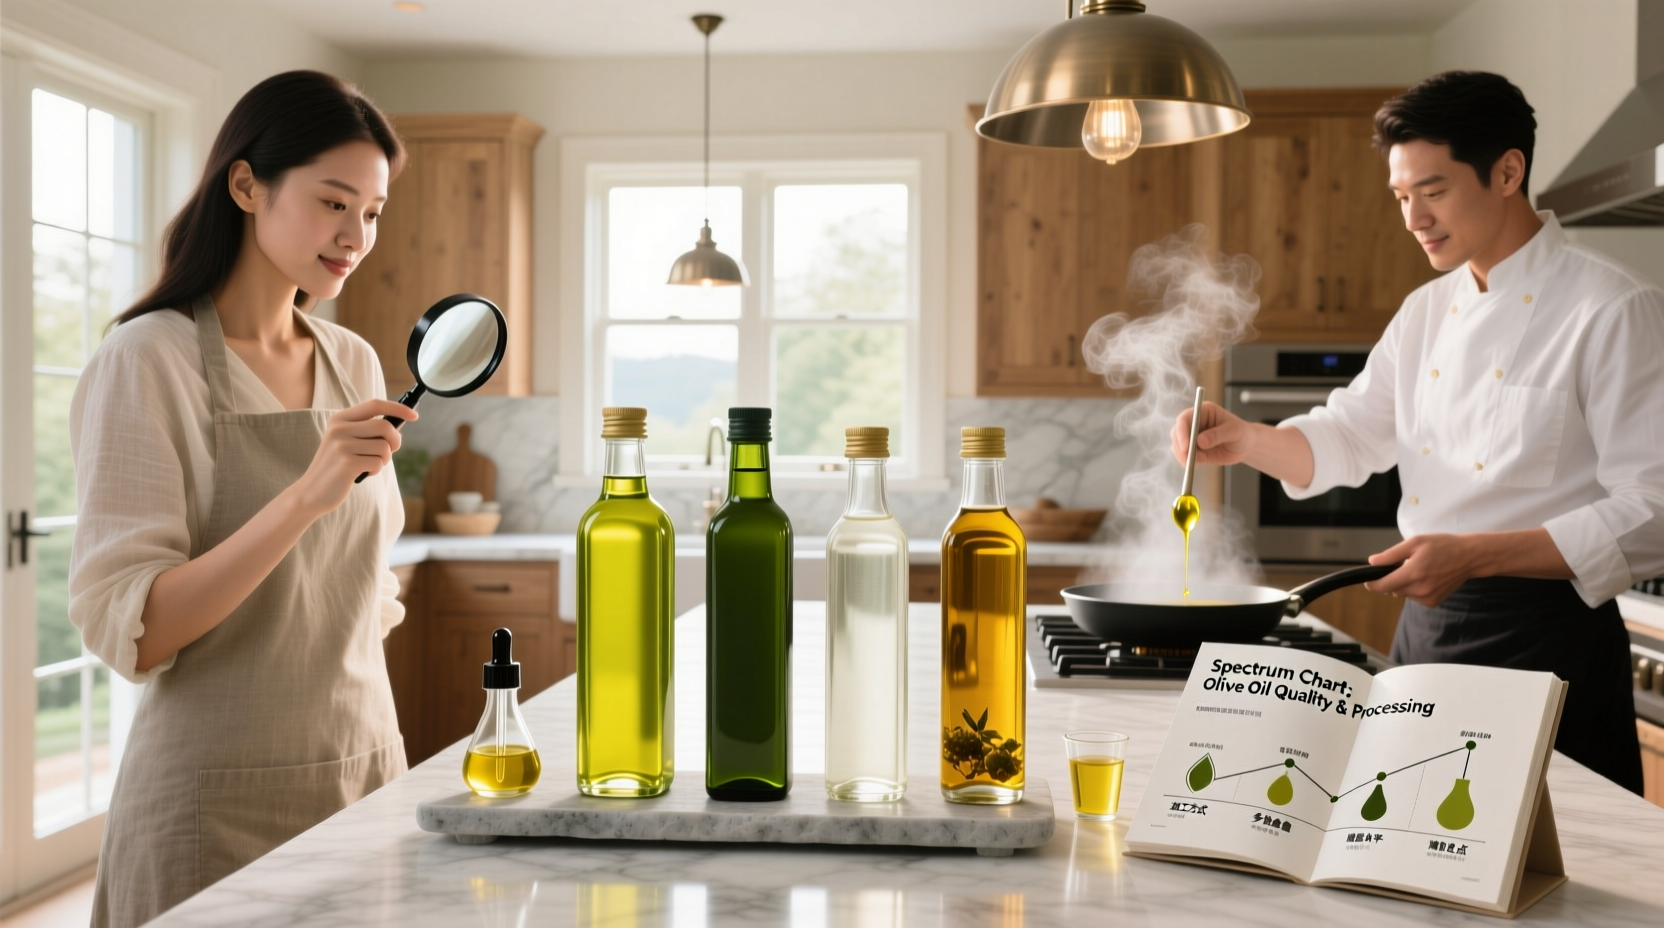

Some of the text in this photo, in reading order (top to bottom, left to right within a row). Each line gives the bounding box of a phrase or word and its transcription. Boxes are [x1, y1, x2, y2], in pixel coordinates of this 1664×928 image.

[1203, 677, 1244, 693] Olive
[1248, 680, 1272, 696] Oil
[1274, 684, 1333, 712] Quality
[1335, 699, 1347, 715] &
[1351, 698, 1436, 719] Processing
[1210, 659, 1352, 698] Spectrum Chart:
